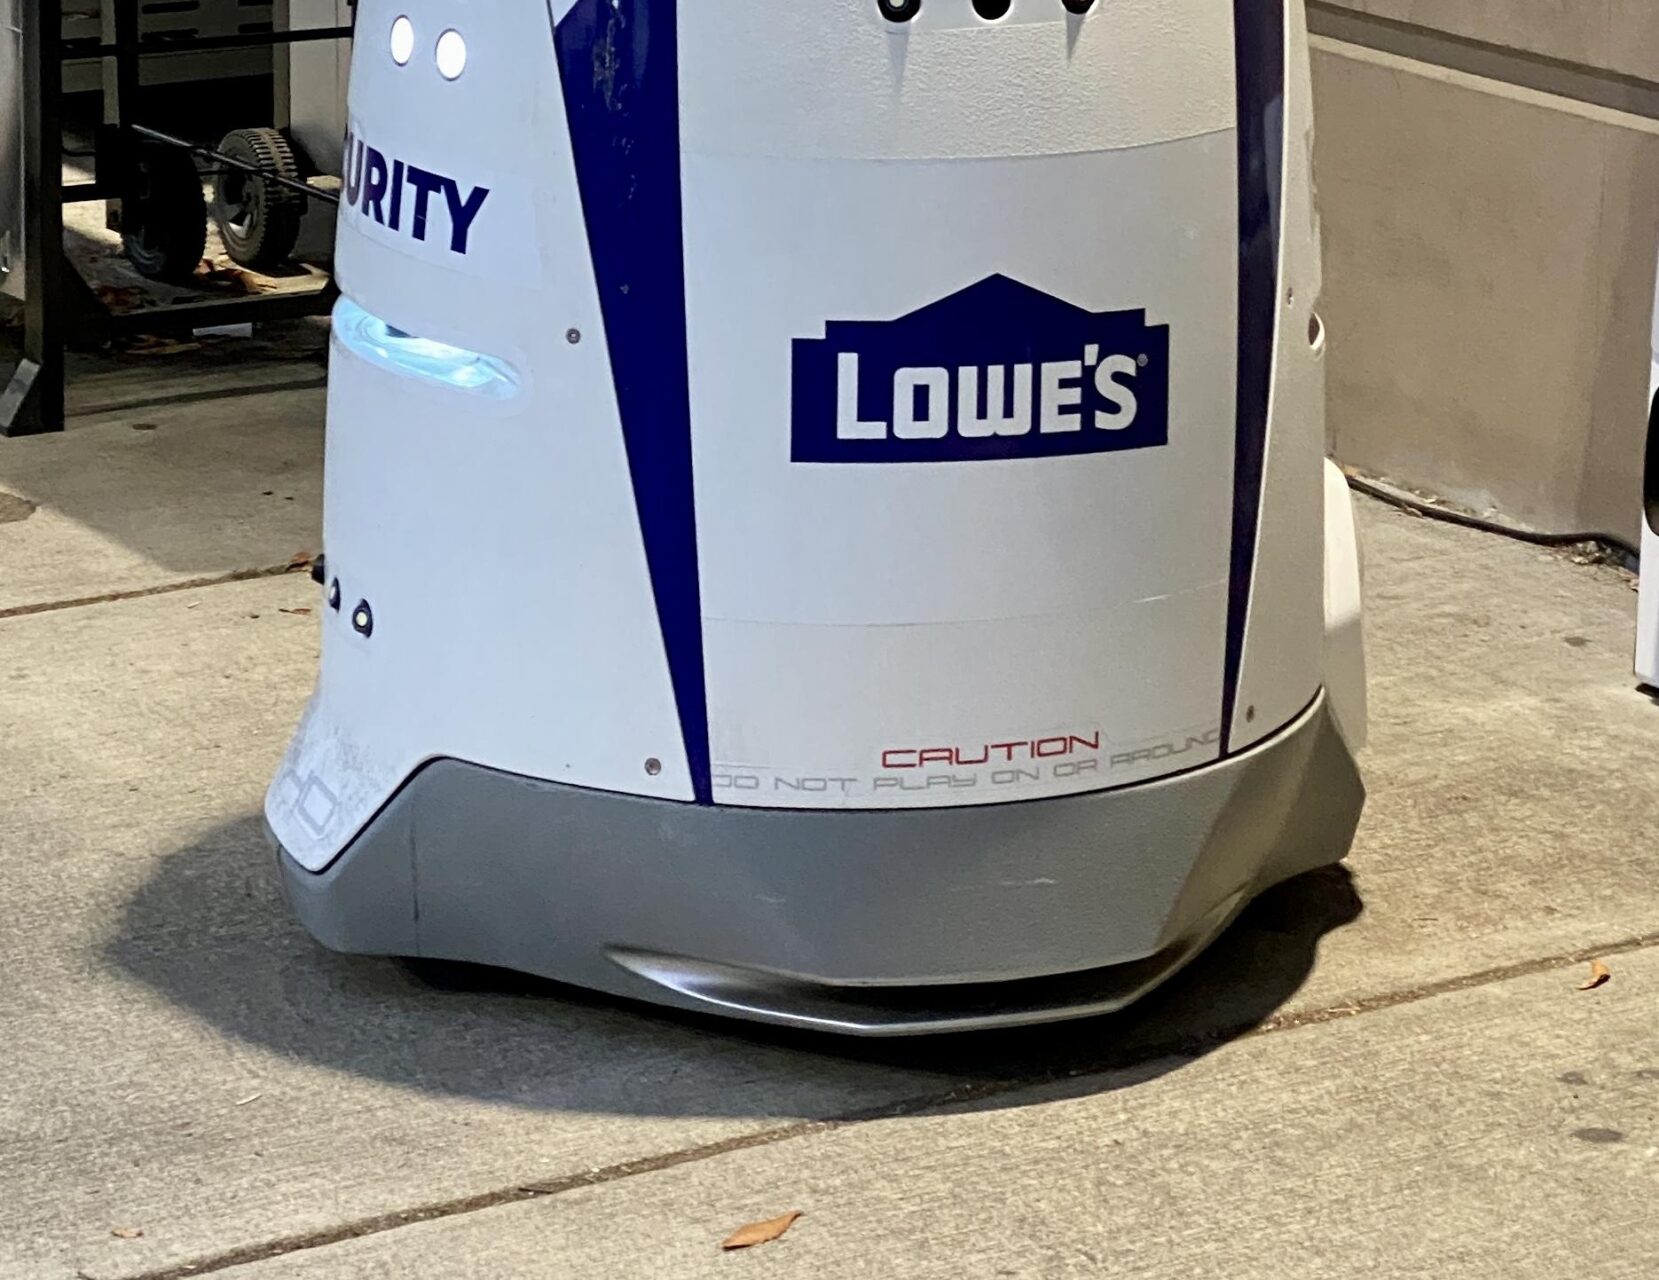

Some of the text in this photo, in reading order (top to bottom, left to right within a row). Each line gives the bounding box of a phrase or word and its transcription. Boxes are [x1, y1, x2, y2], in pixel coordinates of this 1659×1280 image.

[344, 124, 490, 255] URITY
[711, 726, 1221, 792] DO NOT PLAY ON OR AROUND
[881, 730, 1100, 769] CAUTION
